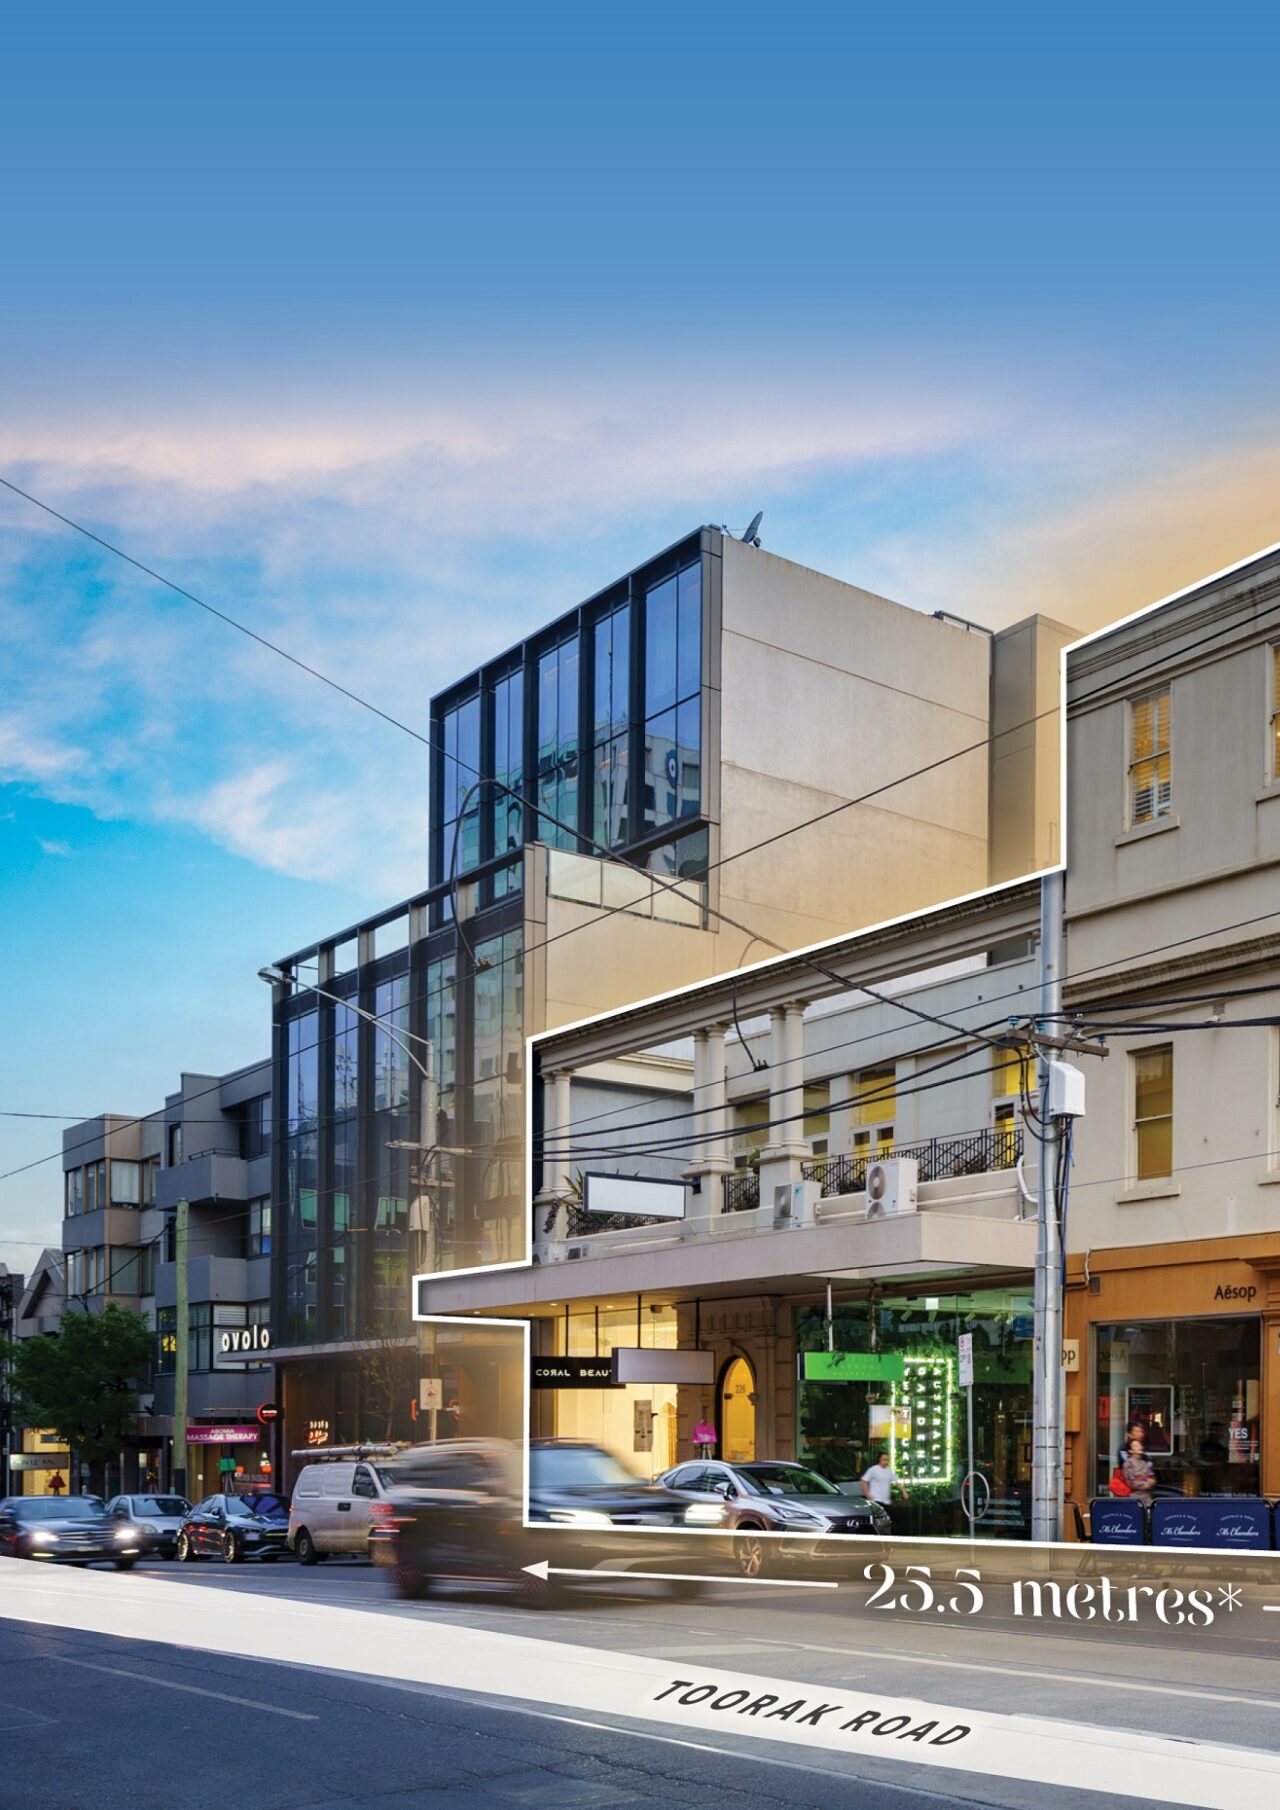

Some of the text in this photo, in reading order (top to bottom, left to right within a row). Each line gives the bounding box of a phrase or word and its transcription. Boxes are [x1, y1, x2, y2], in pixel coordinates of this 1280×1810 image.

[221, 1324, 269, 1351] ovolo
[580, 1369, 613, 1377] BEAU
[932, 1367, 942, 1474] AUSTRALIA
[186, 1432, 258, 1441] MASSAGE THERAPY
[1228, 1428, 1248, 1439] YES
